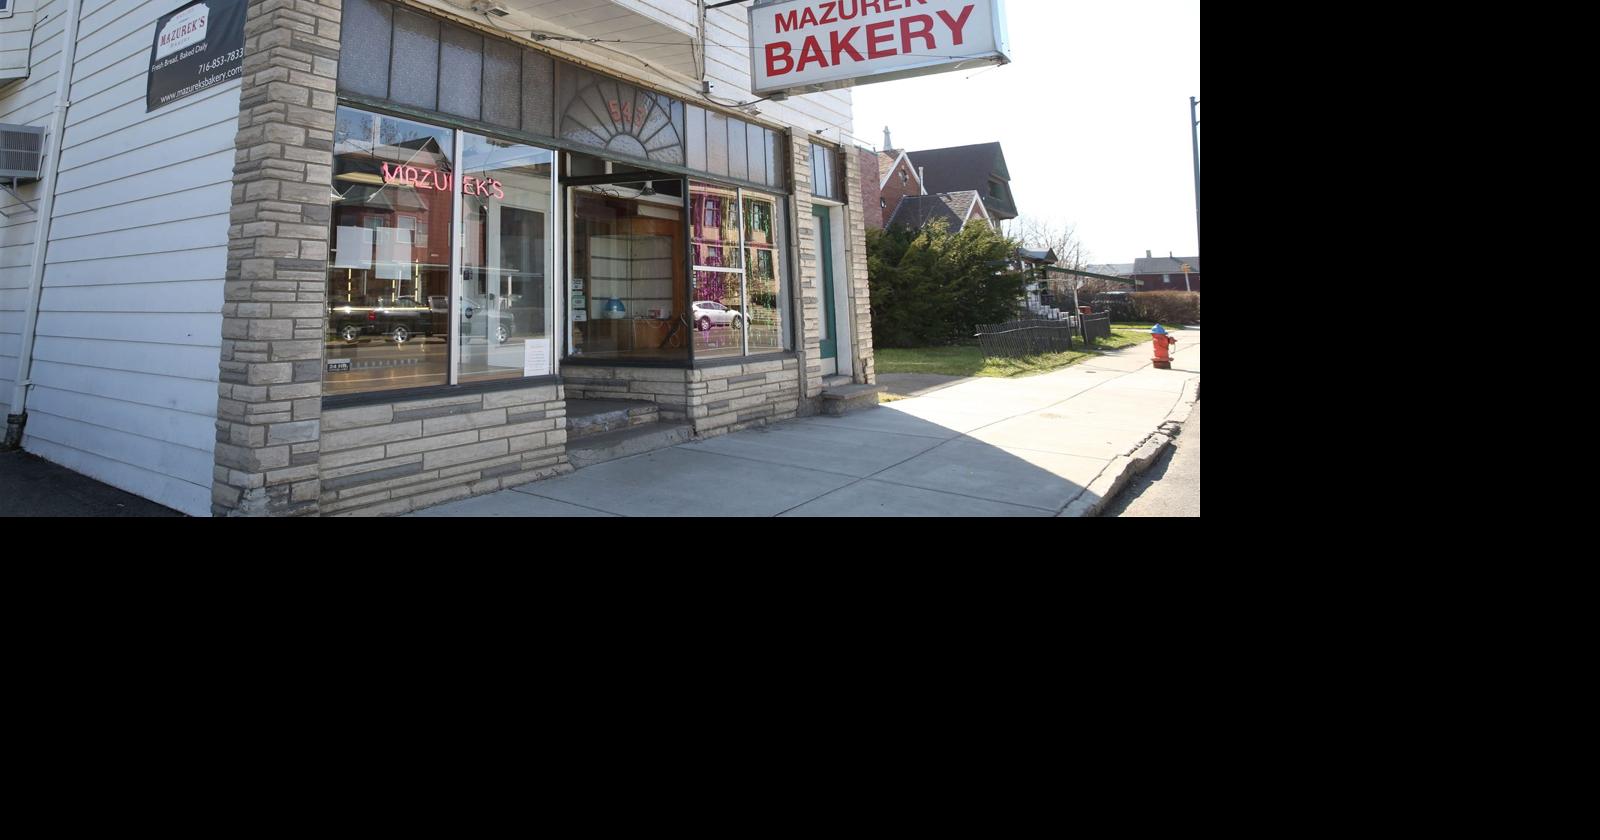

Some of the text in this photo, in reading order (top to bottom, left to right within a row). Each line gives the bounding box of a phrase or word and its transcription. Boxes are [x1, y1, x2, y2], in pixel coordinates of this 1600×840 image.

[160, 16, 205, 46] MAZUREK'S
[765, 5, 974, 77] BAKERY
[151, 62, 163, 72] Fresh
[180, 48, 194, 60] Baked
[195, 43, 208, 54] Daily
[198, 48, 243, 74] 716-853-7833
[160, 66, 242, 103] www.mazureksbakery.com
[382, 162, 504, 199] MAZUEK'S
